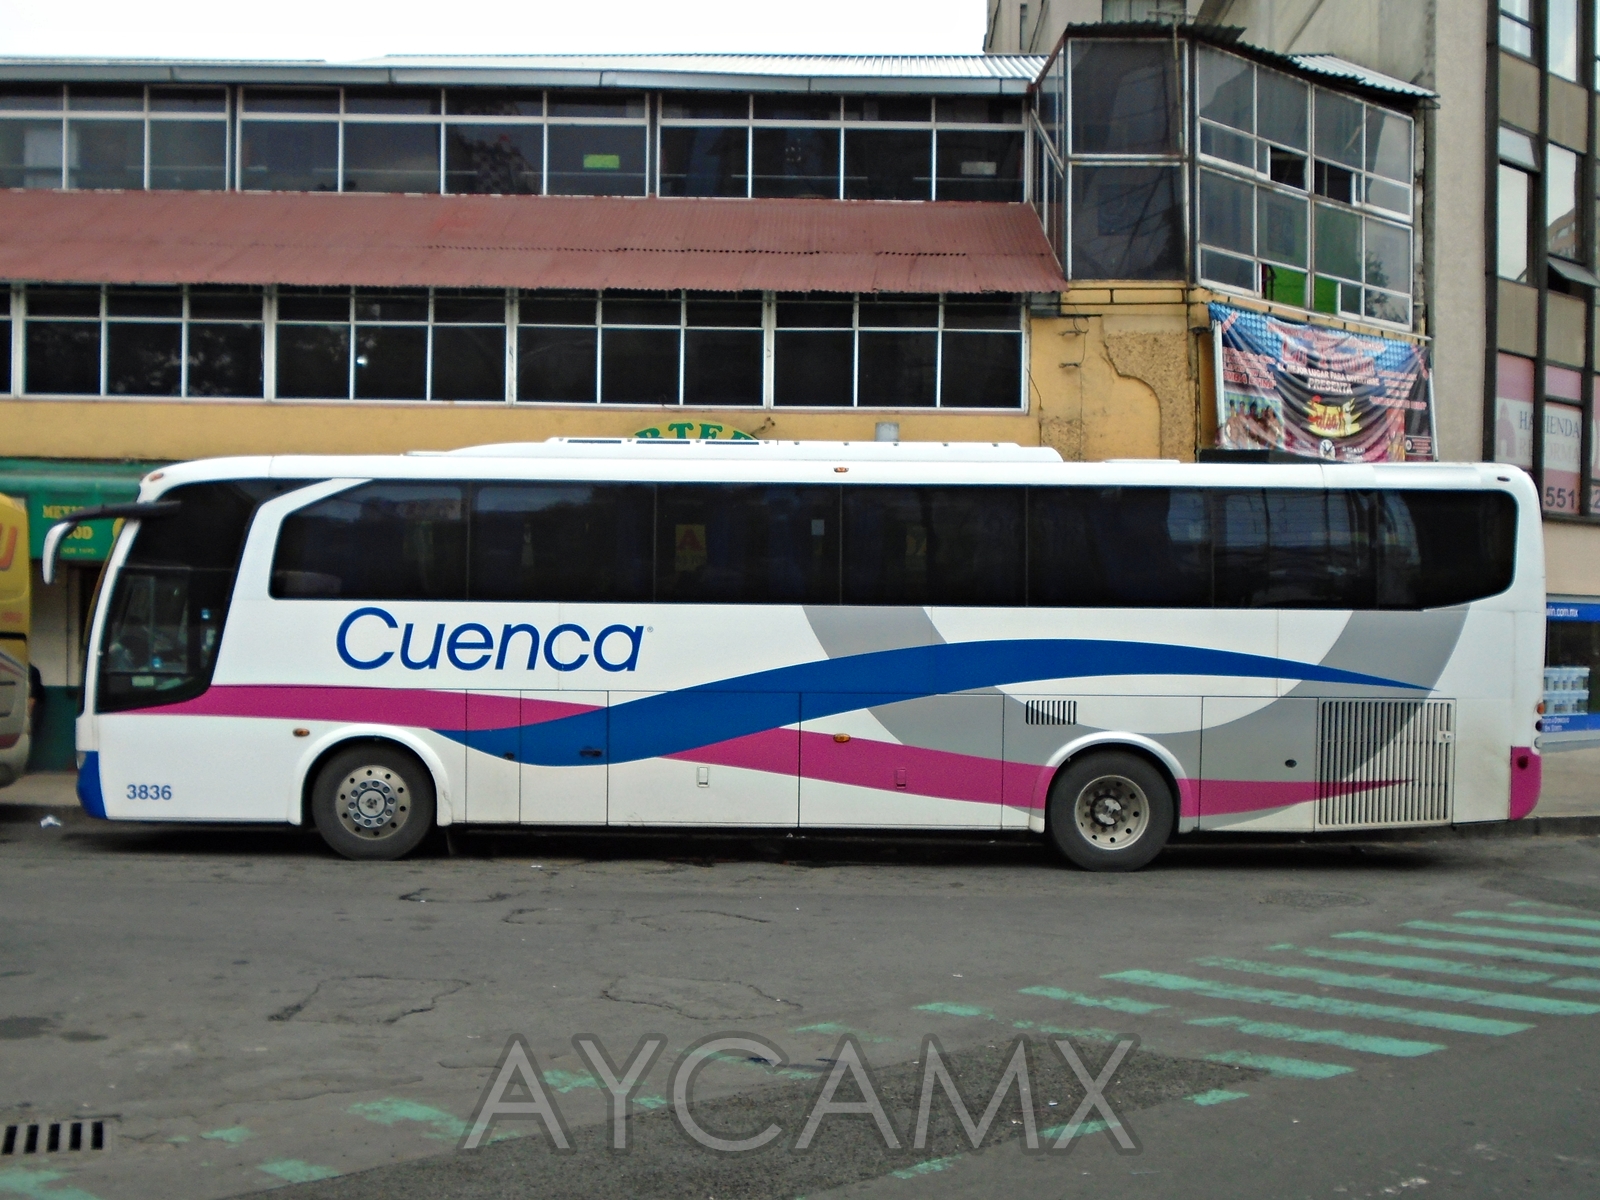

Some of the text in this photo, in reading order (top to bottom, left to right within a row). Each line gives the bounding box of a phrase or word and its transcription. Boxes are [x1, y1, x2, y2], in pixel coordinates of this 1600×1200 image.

[1287, 364, 1308, 377] MEJOR
[1308, 367, 1330, 380] LUGAR
[1330, 371, 1347, 382] PARA
[1307, 377, 1354, 395] PRESENTA
[1519, 410, 1581, 439] HAIENDA
[1545, 486, 1576, 510] 551
[336, 606, 645, 673] Cuenca
[126, 784, 172, 800] 3836
